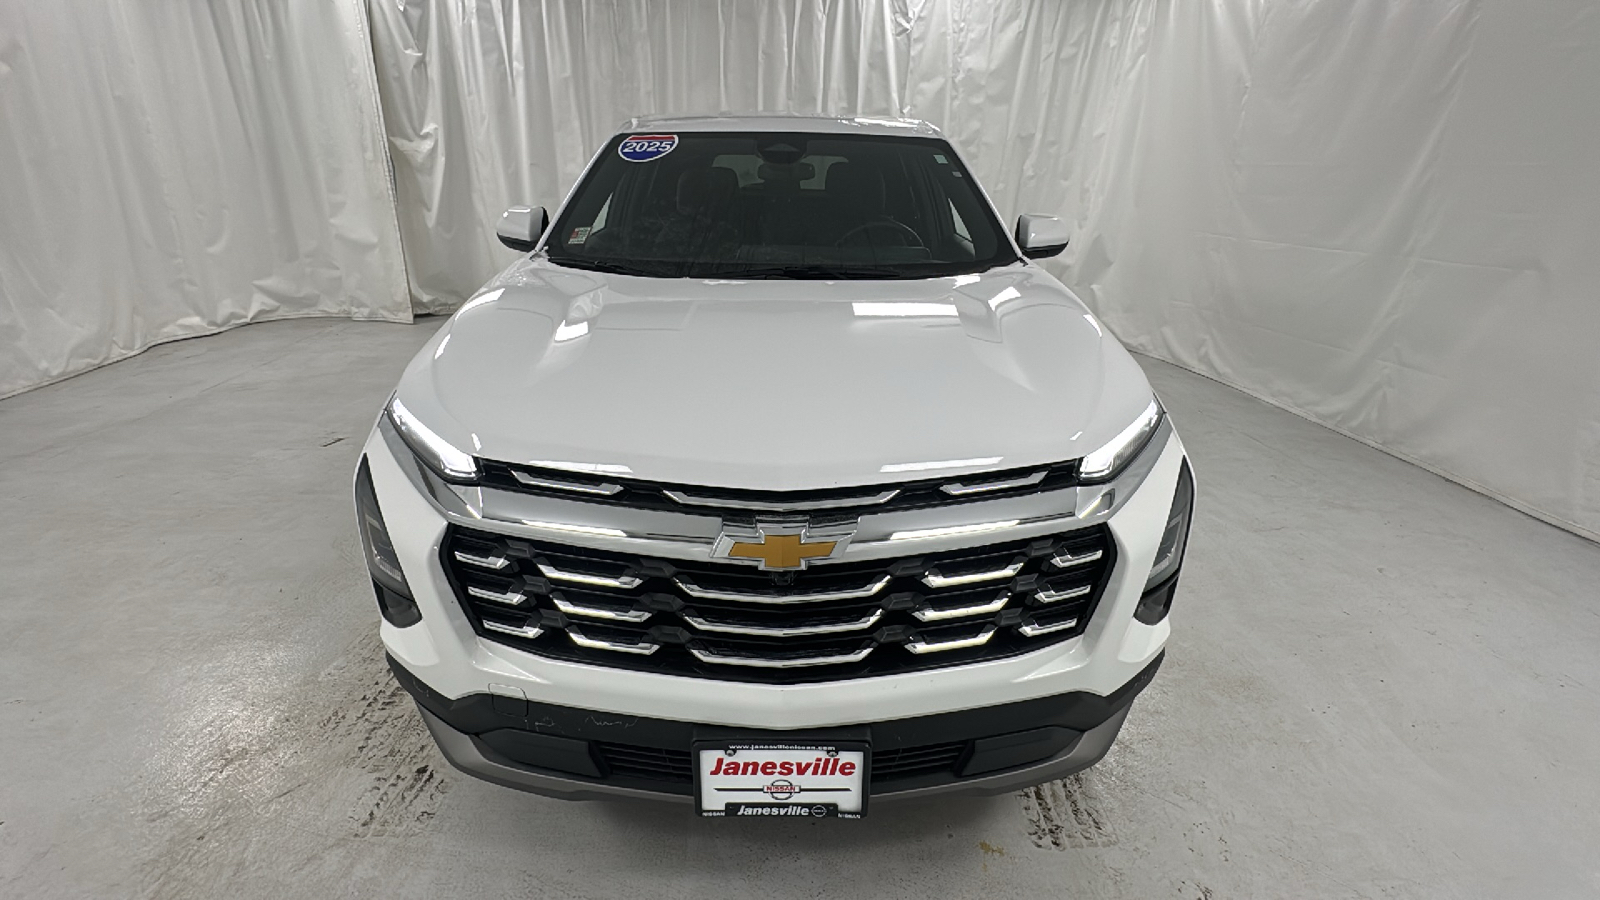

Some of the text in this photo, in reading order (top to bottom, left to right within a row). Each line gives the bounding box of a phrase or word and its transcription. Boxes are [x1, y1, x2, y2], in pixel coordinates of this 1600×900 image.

[622, 141, 673, 153] 2025
[709, 757, 856, 776] Janesville
[737, 804, 810, 816] Janesville
